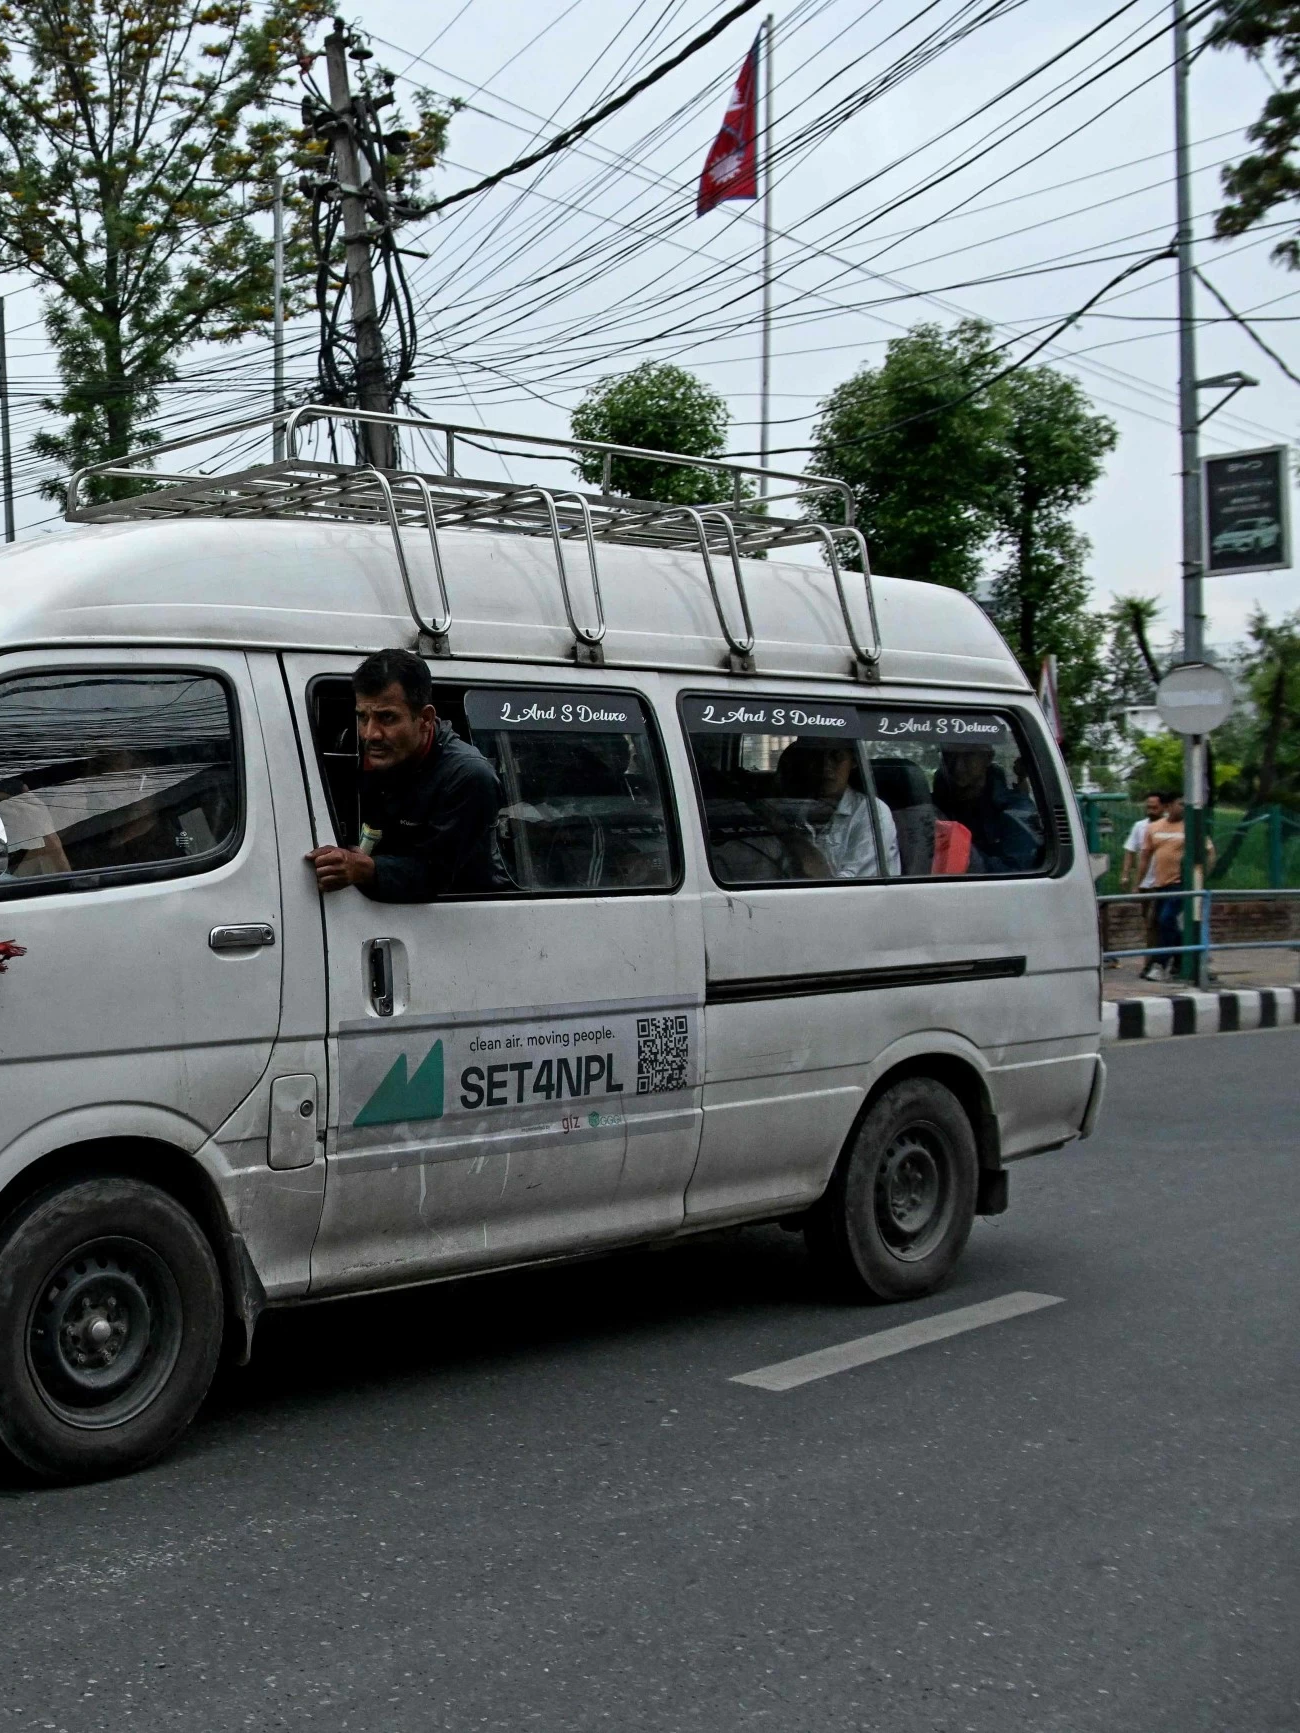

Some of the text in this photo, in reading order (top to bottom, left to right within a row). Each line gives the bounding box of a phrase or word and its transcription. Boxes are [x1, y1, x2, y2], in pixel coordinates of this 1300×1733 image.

[517, 703, 557, 721] And
[561, 704, 573, 723] S
[577, 705, 628, 723] Deluxe
[721, 706, 766, 723] And
[772, 708, 785, 726] S
[789, 709, 847, 727] Deluxe
[894, 717, 932, 733] And
[936, 718, 948, 734] S
[951, 718, 1000, 735] Deluxe
[469, 1025, 615, 1053] clean air. moving people.
[459, 1052, 623, 1110] SET4NPL
[561, 1114, 581, 1134] giz
